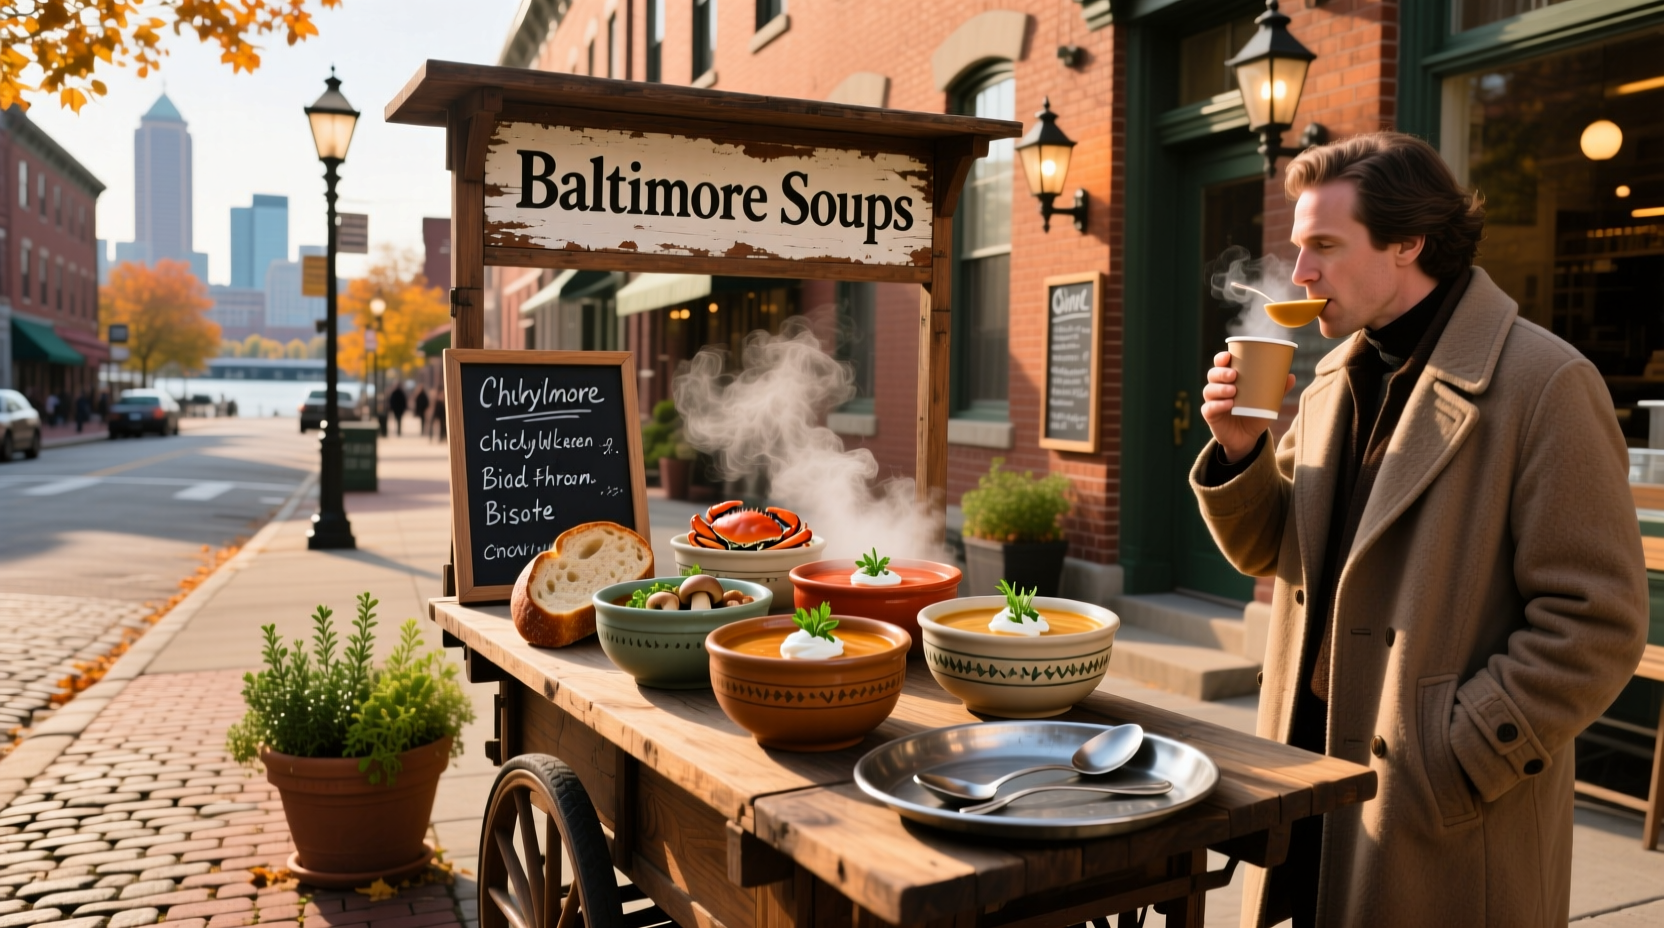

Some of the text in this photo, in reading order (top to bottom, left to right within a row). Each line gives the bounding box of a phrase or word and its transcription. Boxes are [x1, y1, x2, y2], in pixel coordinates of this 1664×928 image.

[516, 149, 914, 245] Baltimore Soups
[485, 498, 555, 526] Bisote
